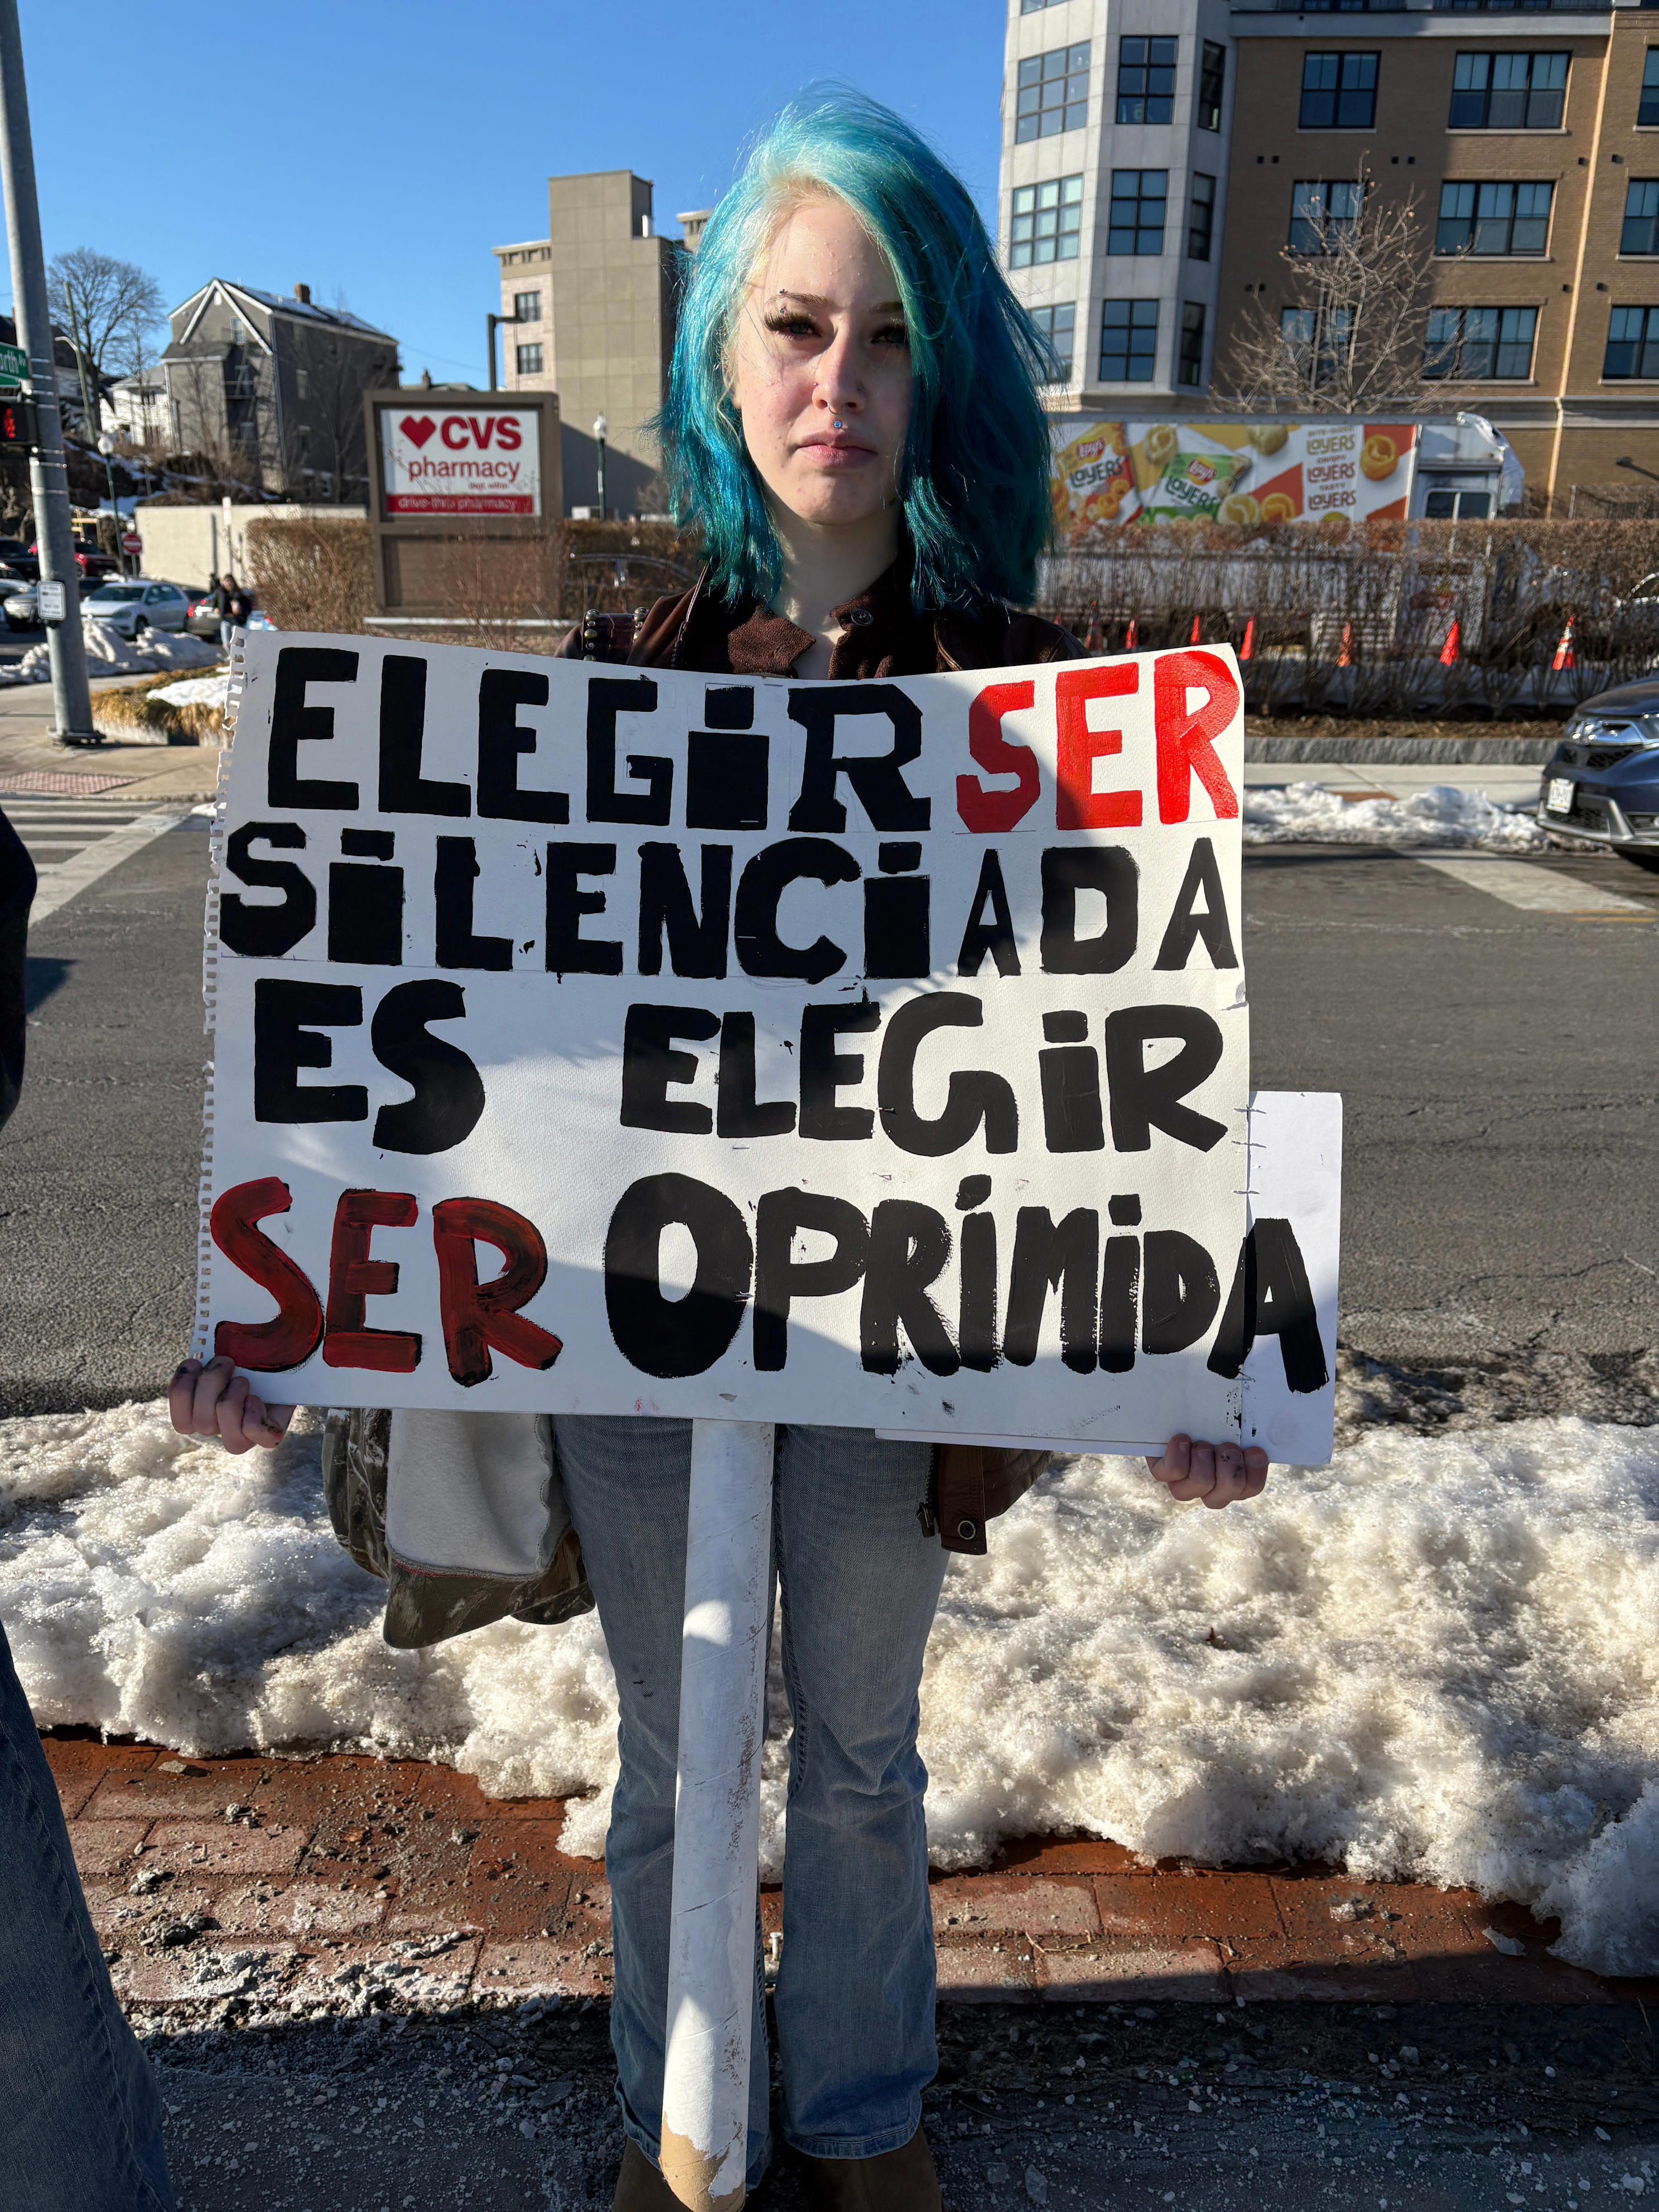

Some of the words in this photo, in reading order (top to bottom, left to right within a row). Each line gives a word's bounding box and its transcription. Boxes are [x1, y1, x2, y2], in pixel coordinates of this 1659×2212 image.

[409, 456, 520, 482] pharmacy
[441, 416, 522, 450] CVS
[956, 650, 1240, 833] SER
[255, 978, 485, 1155] ES
[210, 1176, 563, 1387] SER
